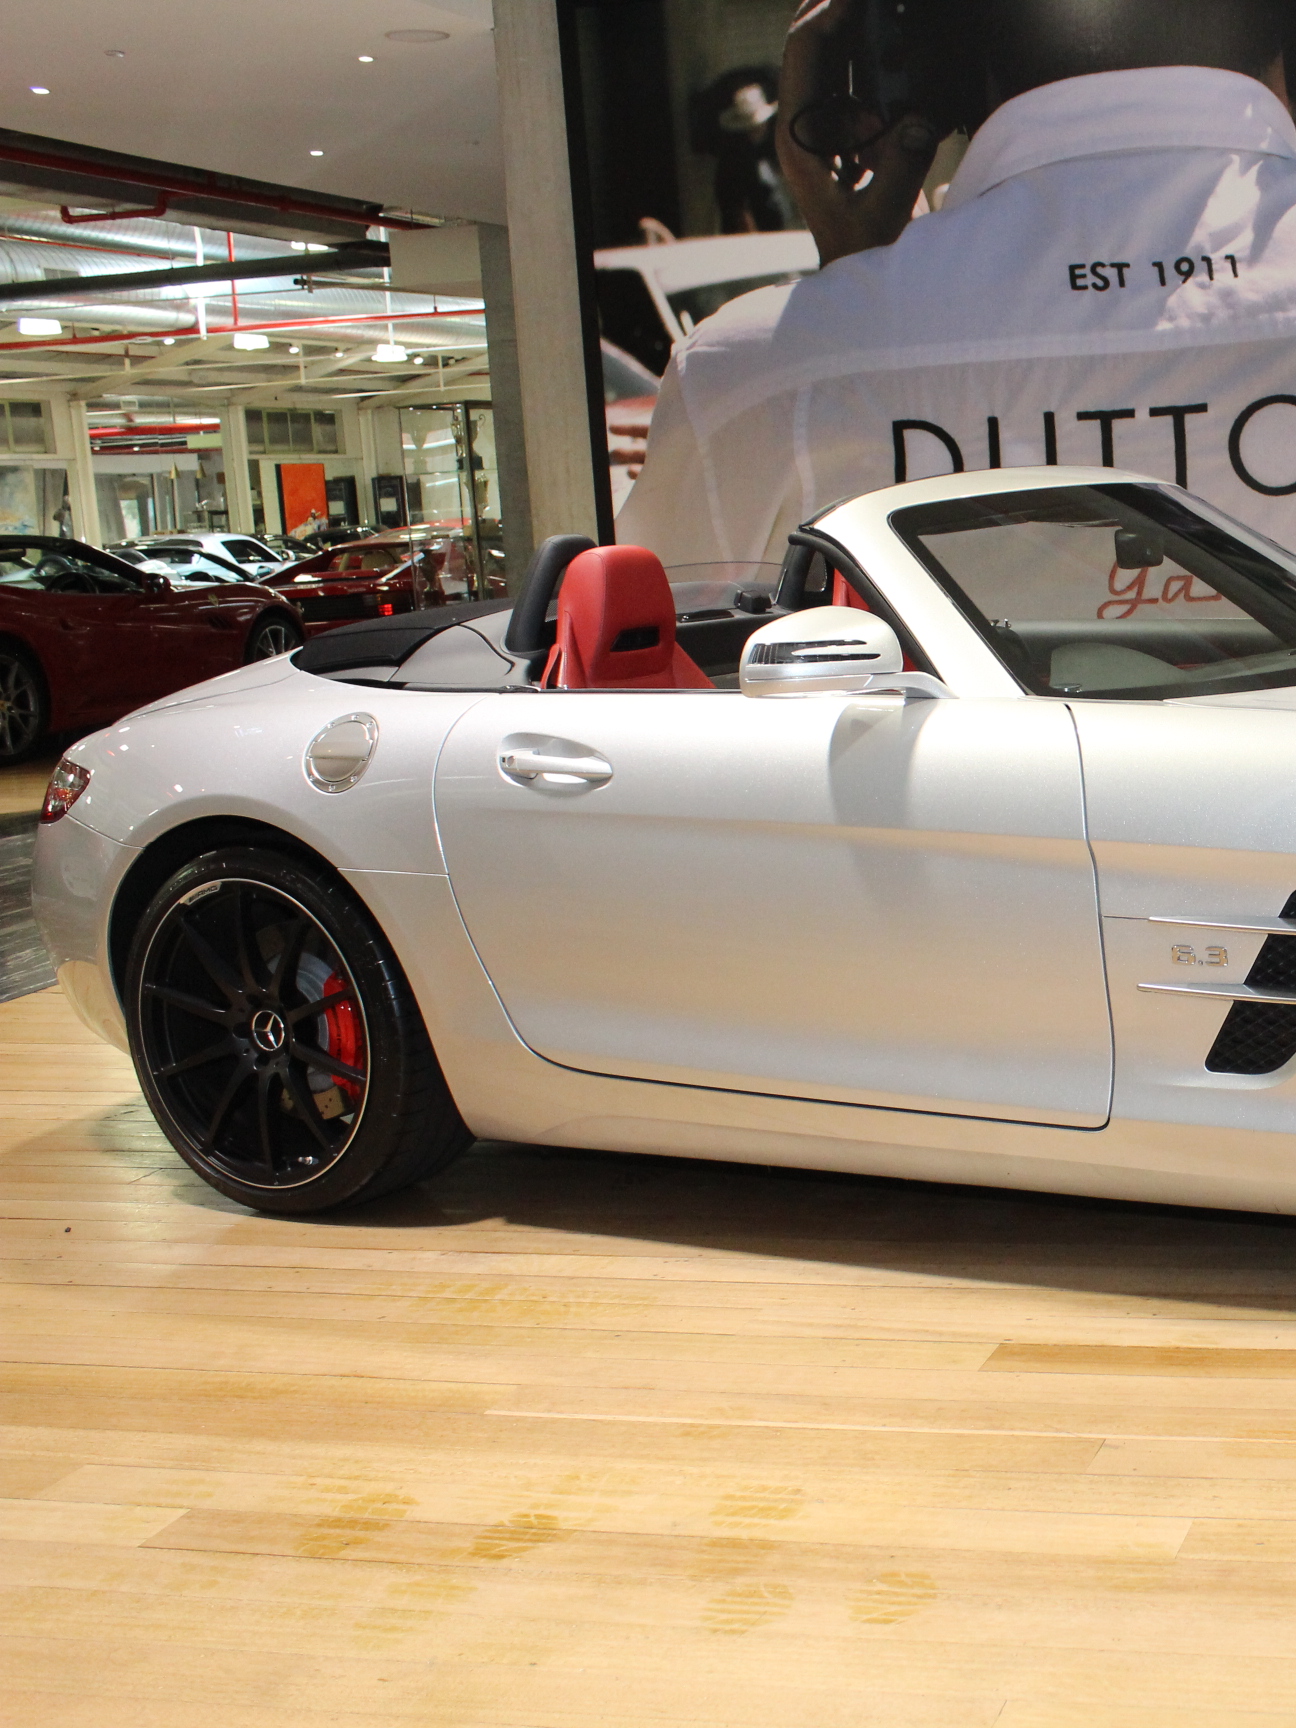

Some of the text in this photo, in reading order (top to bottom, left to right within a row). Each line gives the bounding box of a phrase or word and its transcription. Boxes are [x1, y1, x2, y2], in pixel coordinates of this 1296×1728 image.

[1068, 254, 1239, 292] EST 1911
[1171, 944, 1229, 967] 6.3
